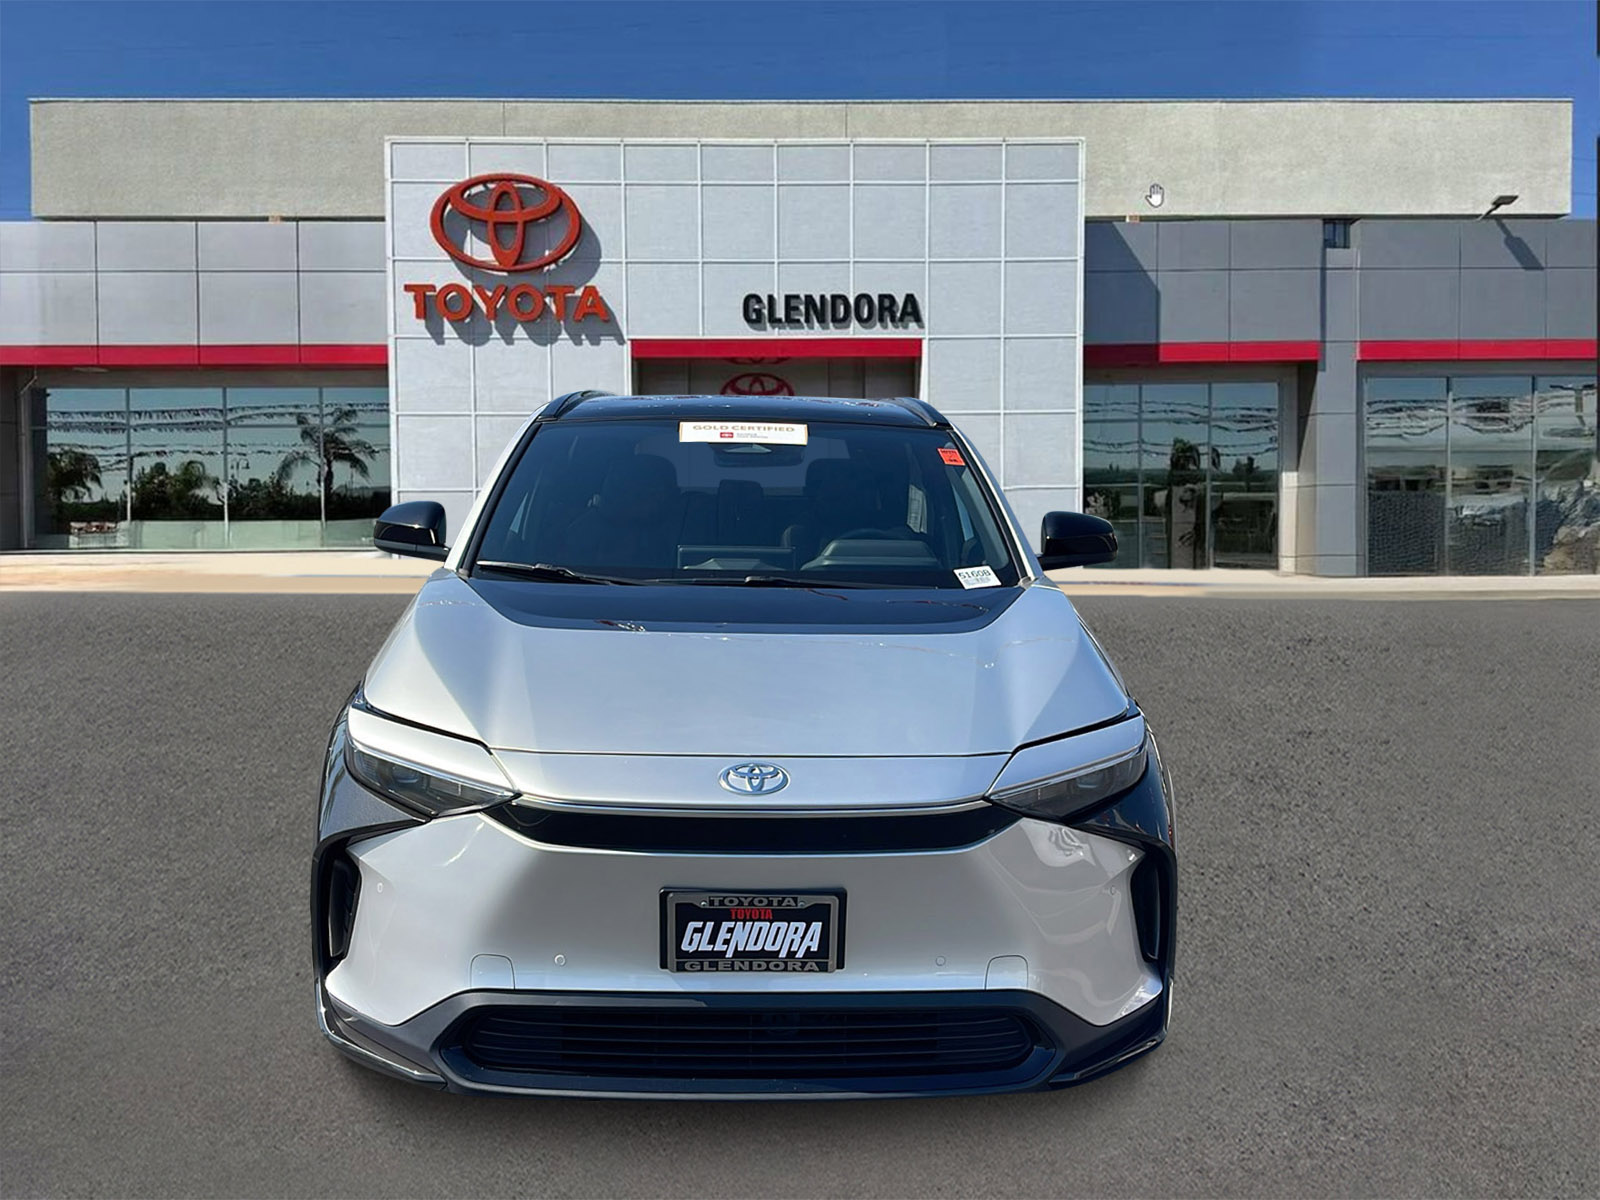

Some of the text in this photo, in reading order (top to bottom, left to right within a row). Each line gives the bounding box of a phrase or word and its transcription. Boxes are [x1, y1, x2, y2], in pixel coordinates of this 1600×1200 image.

[404, 283, 610, 323] TOYOTA
[742, 293, 923, 325] GLENDORA
[710, 897, 796, 907] TOYOTA
[730, 908, 773, 920] TOYOTA
[680, 921, 823, 959] GLENDORA
[684, 961, 820, 972] GLENDORA
